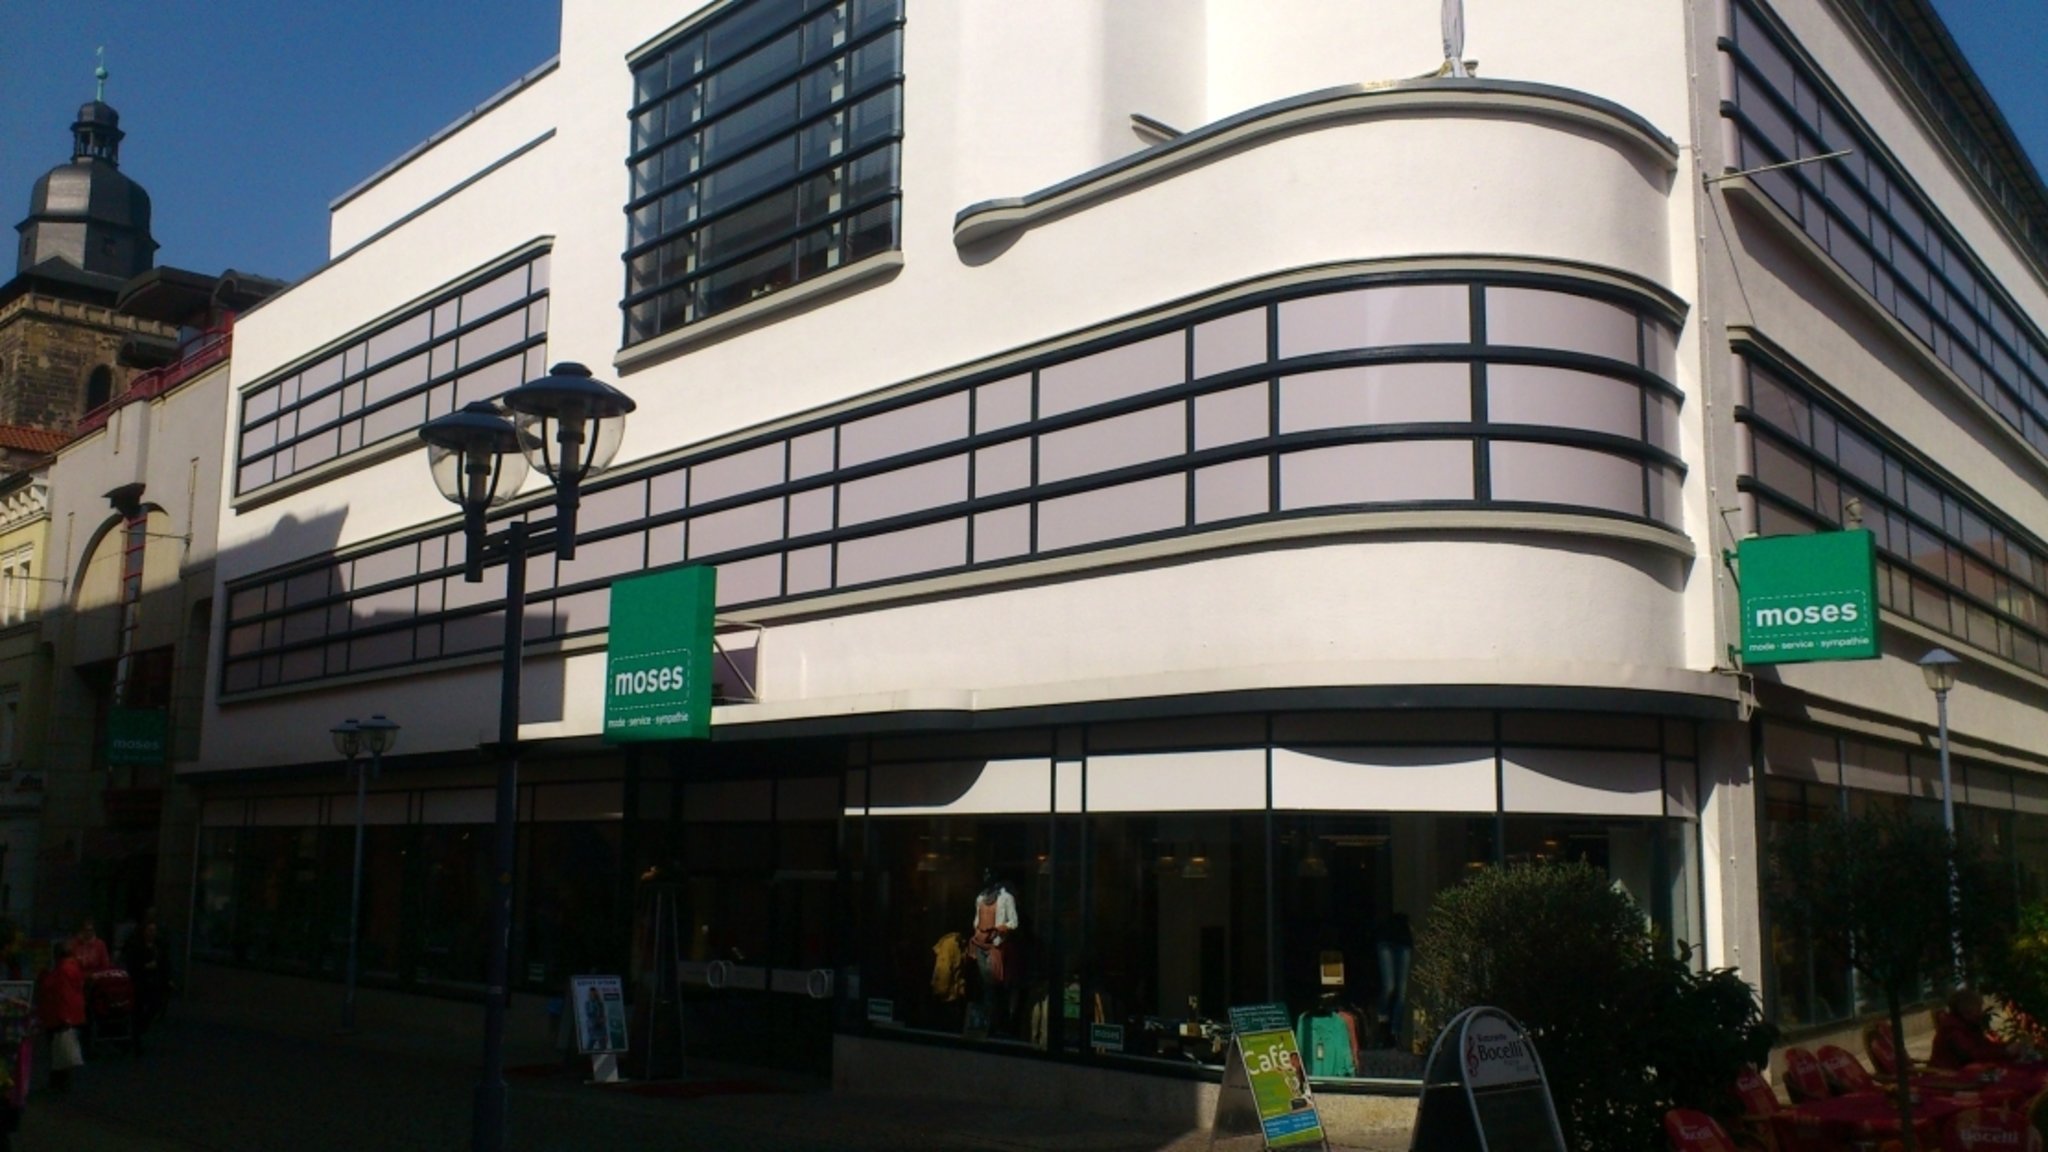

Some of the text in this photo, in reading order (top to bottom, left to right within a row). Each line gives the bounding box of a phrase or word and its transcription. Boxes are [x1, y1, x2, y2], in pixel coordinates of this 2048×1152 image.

[1756, 602, 1857, 627] moses
[1748, 636, 1869, 652] mode service sympathie
[615, 665, 684, 695] moses
[608, 710, 689, 729] mode service sympathie
[113, 738, 160, 751] moses
[1243, 1043, 1291, 1075] Café
[1478, 1040, 1523, 1061] Bocelli
